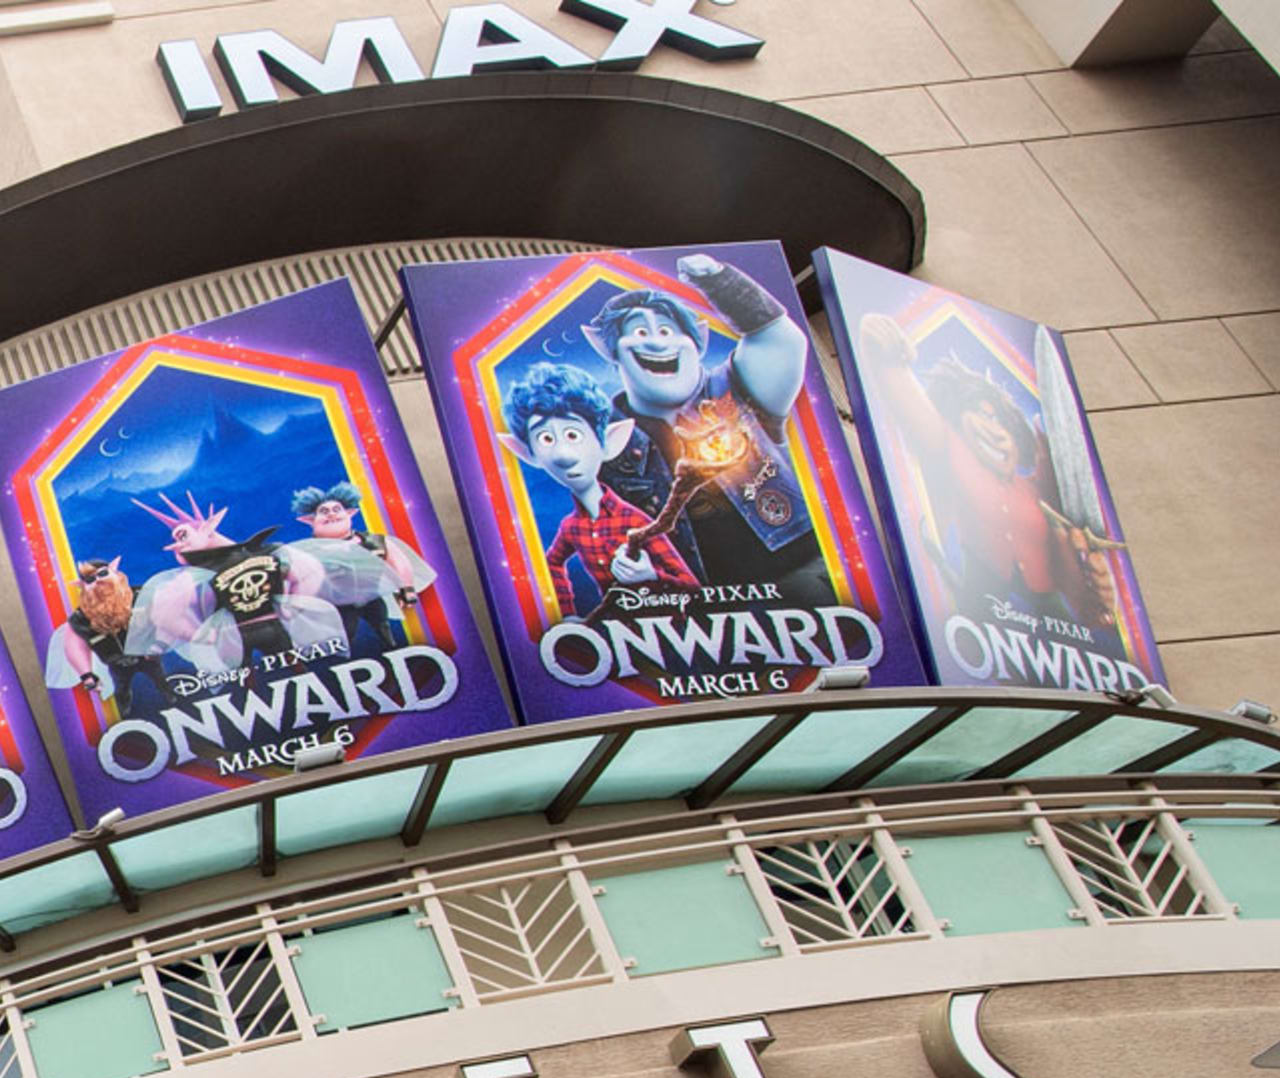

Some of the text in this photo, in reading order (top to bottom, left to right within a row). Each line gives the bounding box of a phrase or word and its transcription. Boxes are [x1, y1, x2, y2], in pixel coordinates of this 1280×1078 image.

[157, 0, 765, 122] IMAX
[700, 583, 782, 603] PIXAR
[540, 605, 884, 688] ONWARD
[1043, 615, 1094, 643] PIXAR
[261, 637, 347, 672] PIXAR
[657, 670, 789, 699] MARCH 6
[97, 645, 459, 783] ONWARD
[216, 724, 355, 776] MARCH 6
